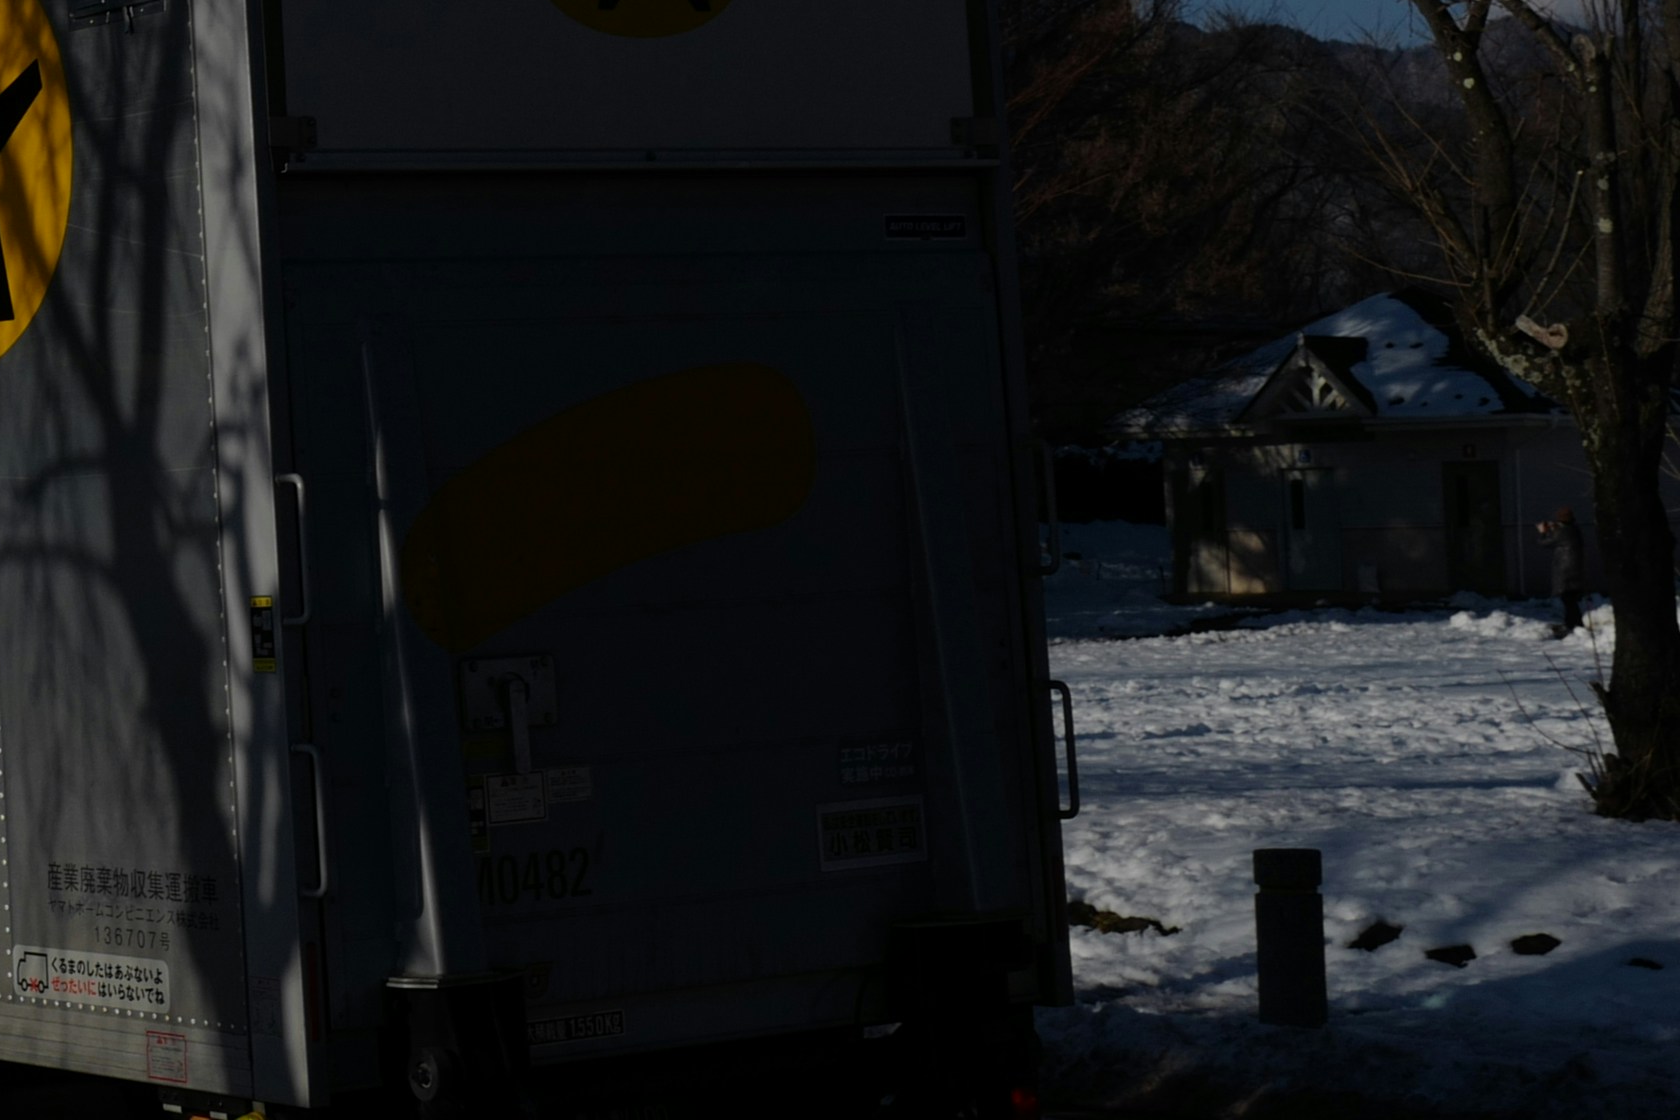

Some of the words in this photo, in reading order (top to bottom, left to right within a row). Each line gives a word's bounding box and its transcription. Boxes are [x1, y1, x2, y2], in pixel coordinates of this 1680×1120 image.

[47, 863, 219, 905] 産業廃棄物収集運搬車
[49, 899, 220, 930] ヤマトホームコンビニエンス株式会社
[94, 926, 171, 951] 136707号
[51, 956, 164, 985] くるまのしたはあぶないよ
[51, 978, 165, 1005] ぜったいにはいらないでね
